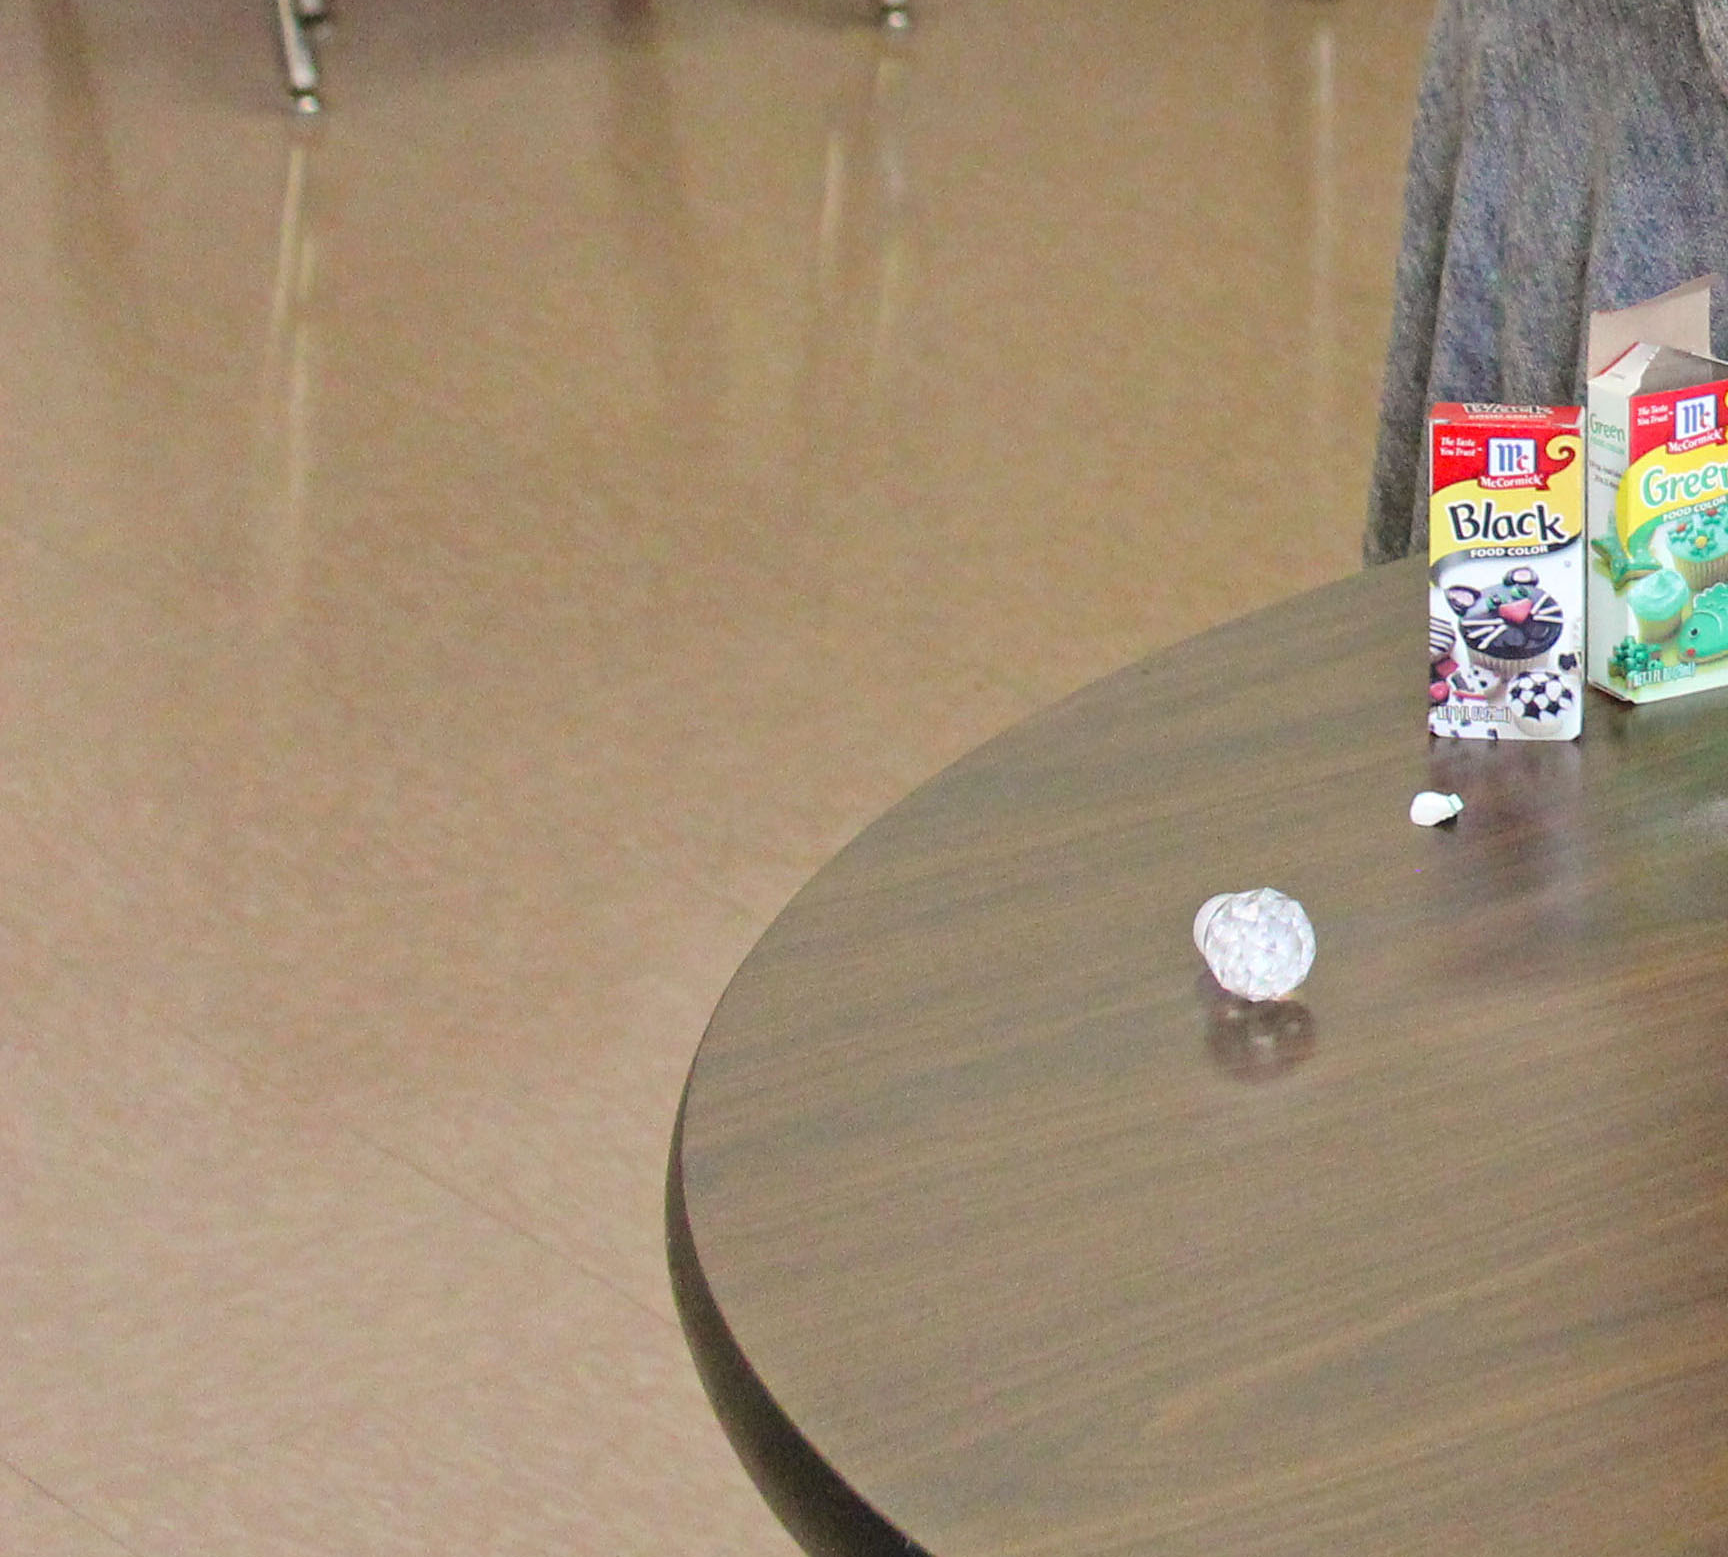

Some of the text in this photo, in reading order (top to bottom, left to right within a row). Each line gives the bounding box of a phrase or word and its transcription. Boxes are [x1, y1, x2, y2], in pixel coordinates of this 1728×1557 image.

[1667, 430, 1722, 453] McCormick
[1480, 474, 1543, 489] McCormick
[1447, 500, 1566, 542] Black
[1663, 507, 1692, 522] FOOD
[1470, 544, 1549, 558] FOOD COLOR
